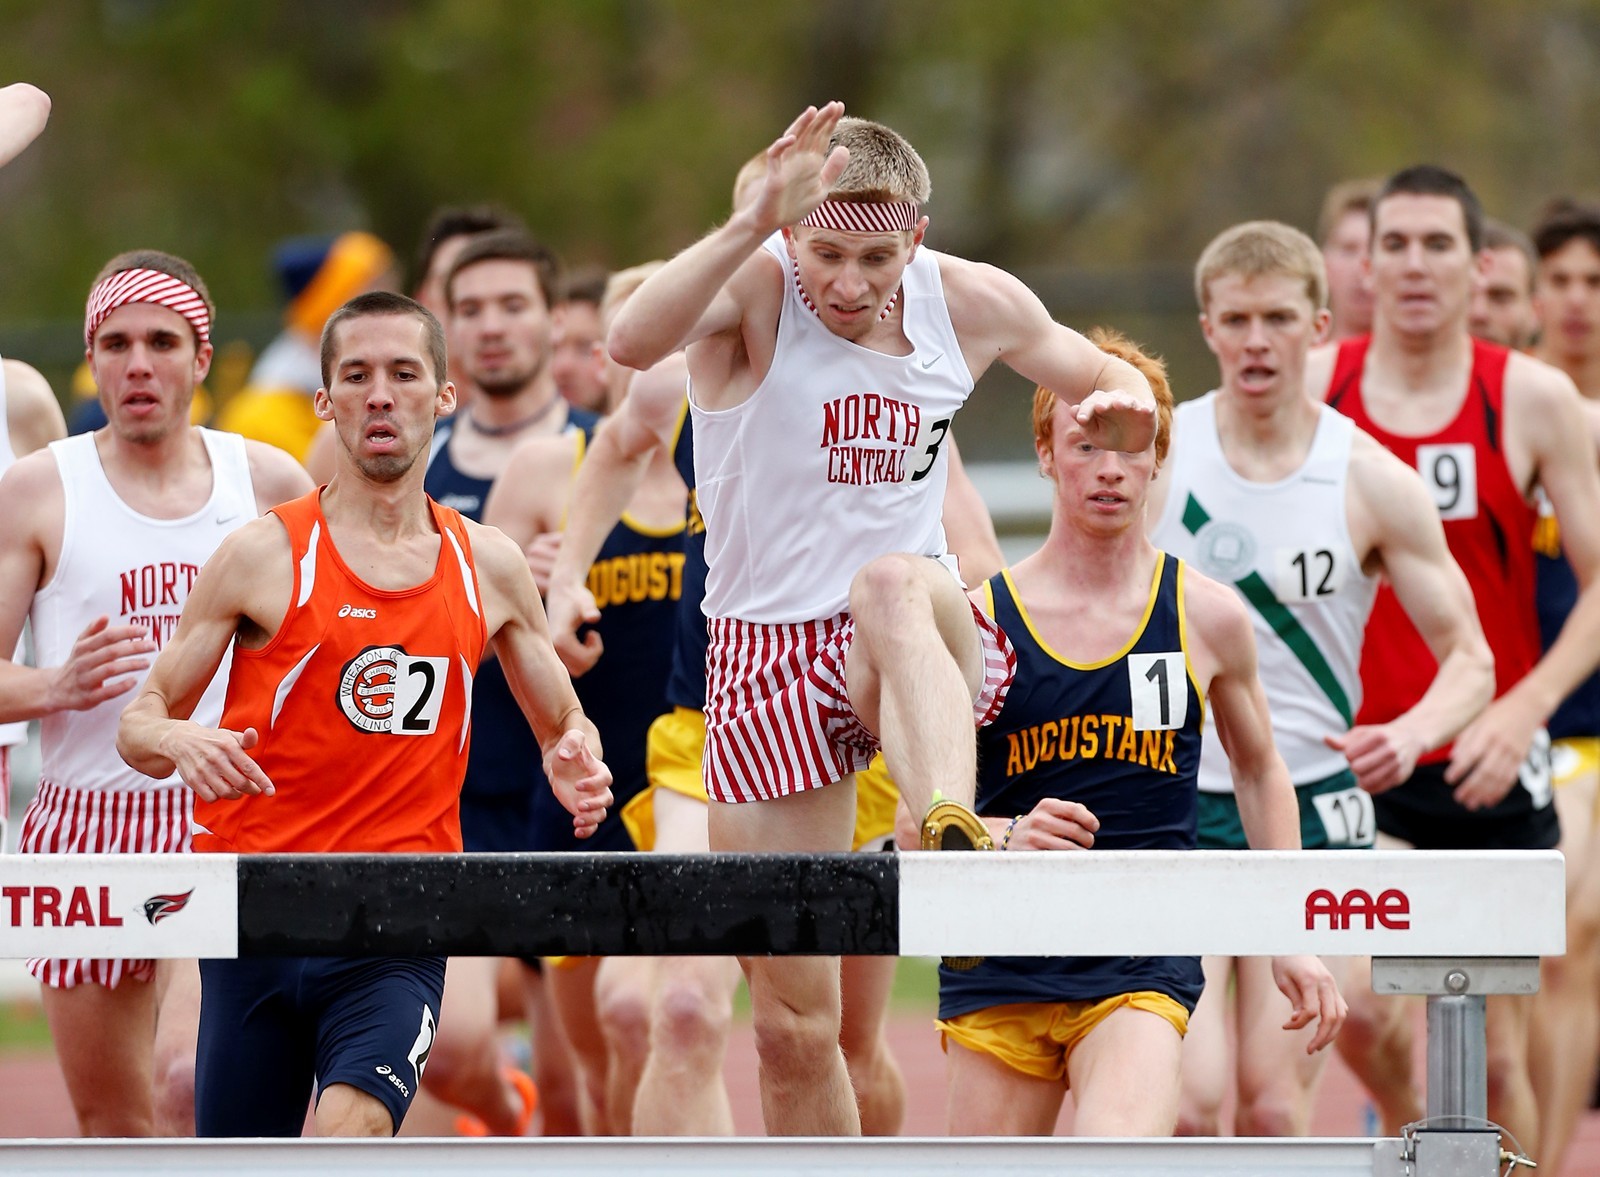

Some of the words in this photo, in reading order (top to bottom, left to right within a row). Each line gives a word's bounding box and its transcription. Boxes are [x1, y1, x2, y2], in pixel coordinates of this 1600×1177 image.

[820, 393, 921, 449] NORTH
[827, 446, 905, 486] CENTRAL
[910, 418, 950, 482] 3
[1433, 453, 1461, 511] 9
[119, 561, 201, 617] NORT
[585, 552, 686, 610] UGUST
[1291, 549, 1335, 597] 12
[348, 607, 377, 619] asics
[341, 650, 383, 698] WHEATON
[373, 685, 396, 694] REGN
[402, 661, 435, 730] 2
[1145, 659, 1170, 725] 1
[352, 712, 394, 731] ILLINO
[1332, 794, 1366, 842] 12
[2, 886, 124, 927] TRAL
